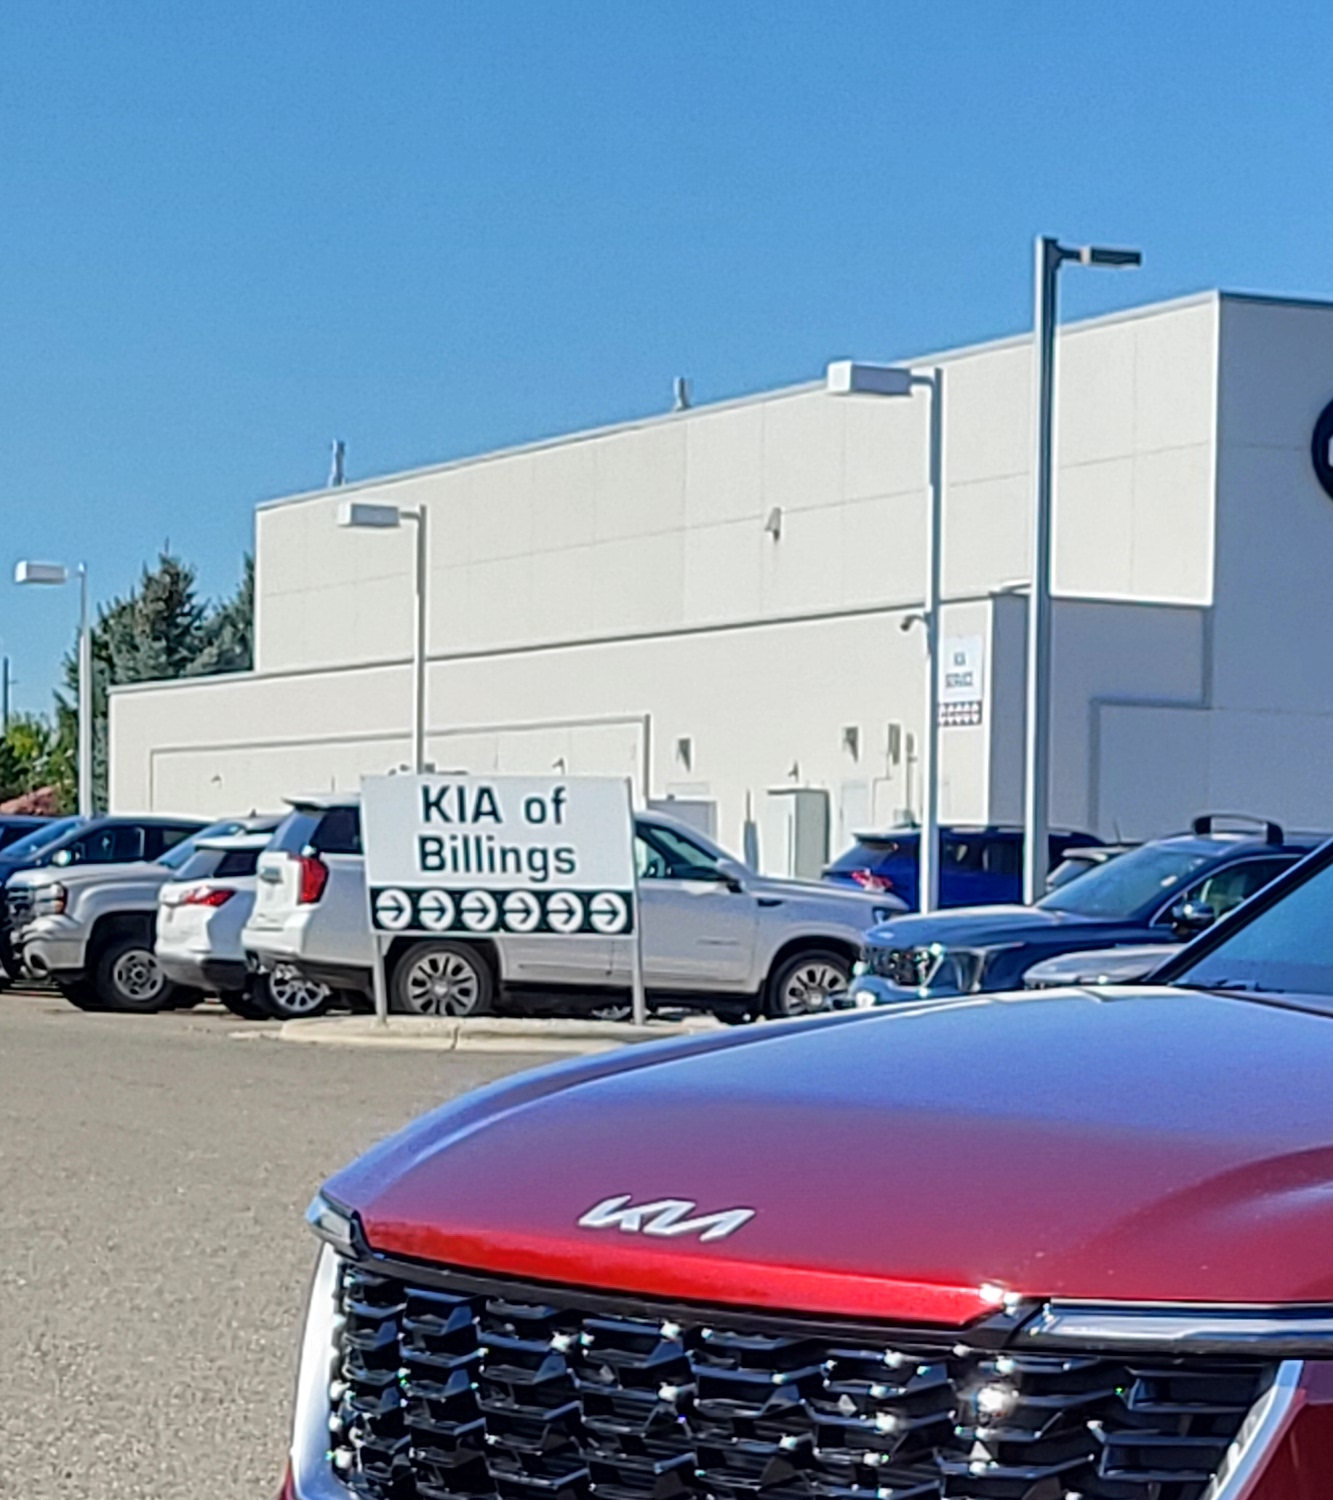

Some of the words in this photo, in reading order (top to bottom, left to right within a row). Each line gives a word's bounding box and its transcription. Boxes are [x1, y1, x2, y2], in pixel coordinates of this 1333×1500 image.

[421, 784, 503, 824] KIA
[523, 786, 567, 824] of
[418, 834, 577, 883] Billings
[578, 1195, 756, 1242] KIA
